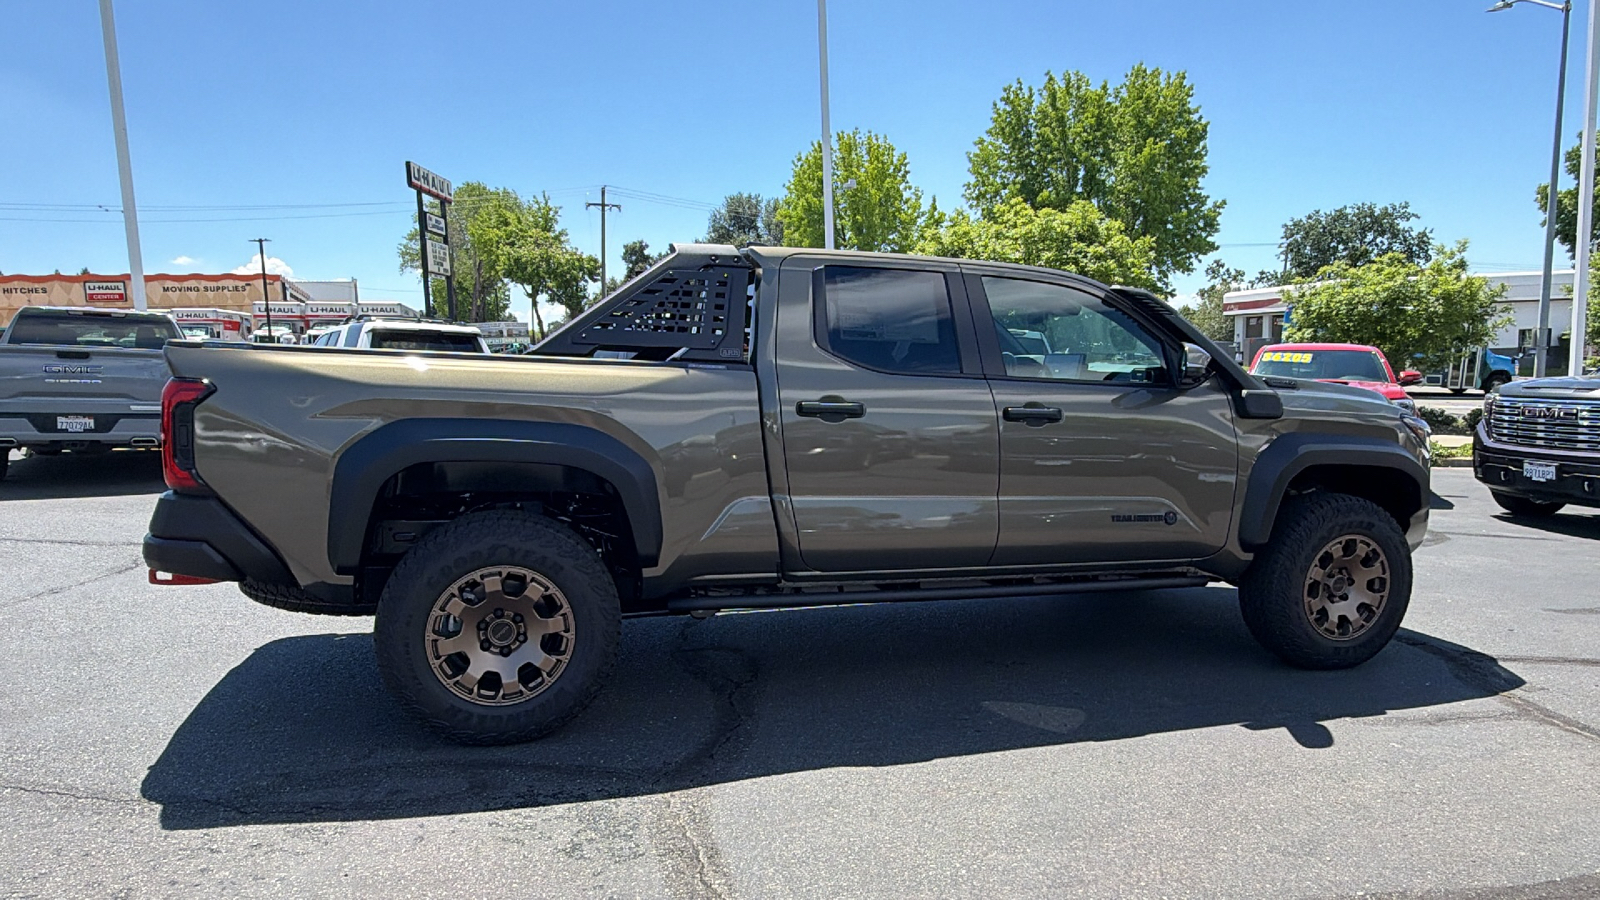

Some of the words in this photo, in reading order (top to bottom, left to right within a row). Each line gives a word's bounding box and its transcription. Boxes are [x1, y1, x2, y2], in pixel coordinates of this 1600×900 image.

[310, 306, 347, 314] U-HAUL
[361, 306, 398, 314] U-HAUL
[43, 365, 104, 374] GMC
[1523, 407, 1577, 419] GMC
